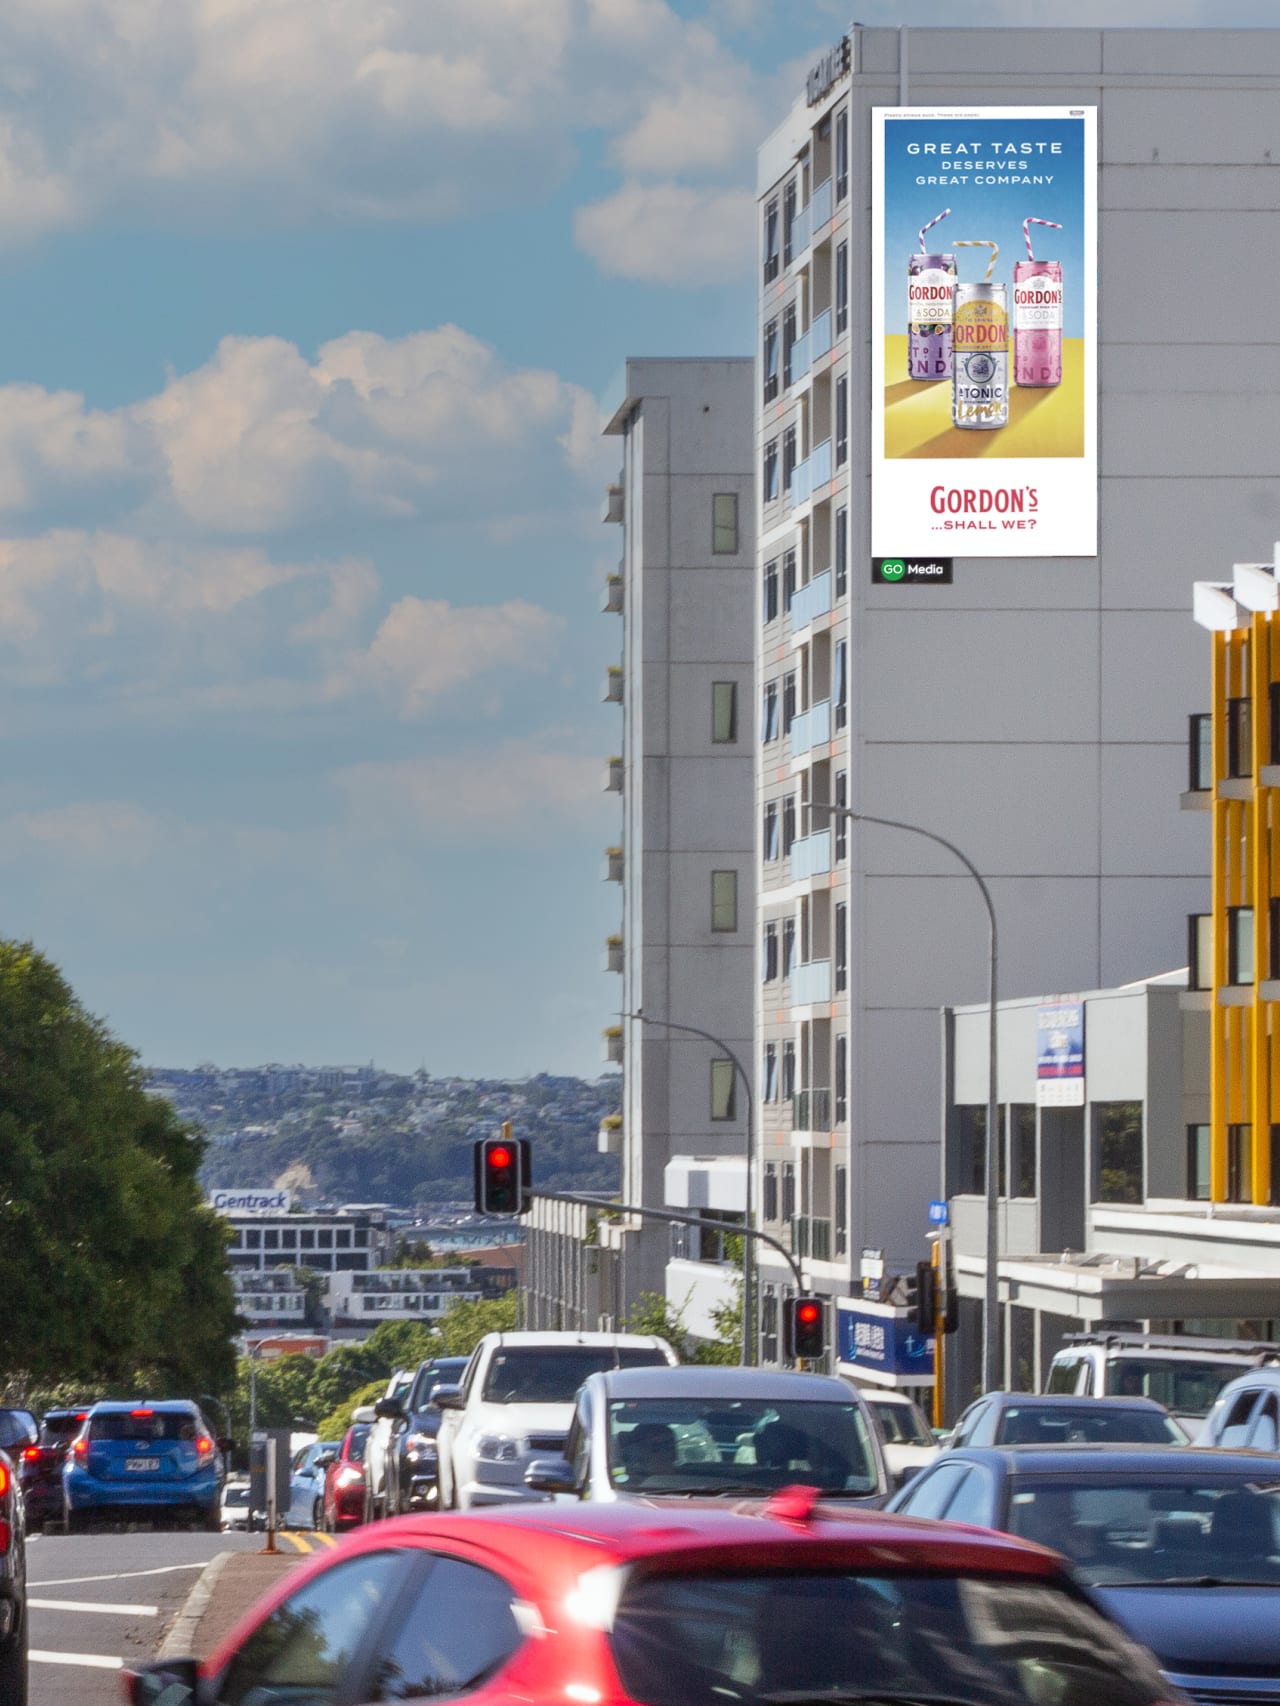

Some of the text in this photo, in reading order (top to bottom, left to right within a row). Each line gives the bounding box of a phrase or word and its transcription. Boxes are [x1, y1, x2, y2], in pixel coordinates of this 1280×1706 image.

[907, 142, 1063, 155] GREAT TASTE
[942, 160, 1028, 170] DESERVES
[915, 175, 1054, 185] GREAT COMPANY
[909, 285, 952, 300] GORDON
[923, 307, 950, 317] SODA
[952, 324, 1008, 343] ORDON
[965, 387, 1002, 399] TONIC
[930, 485, 1038, 514] GORDON'S
[1002, 519, 1037, 530] WE?
[884, 564, 943, 575] GO Media
[214, 1192, 287, 1209] Gentrack
